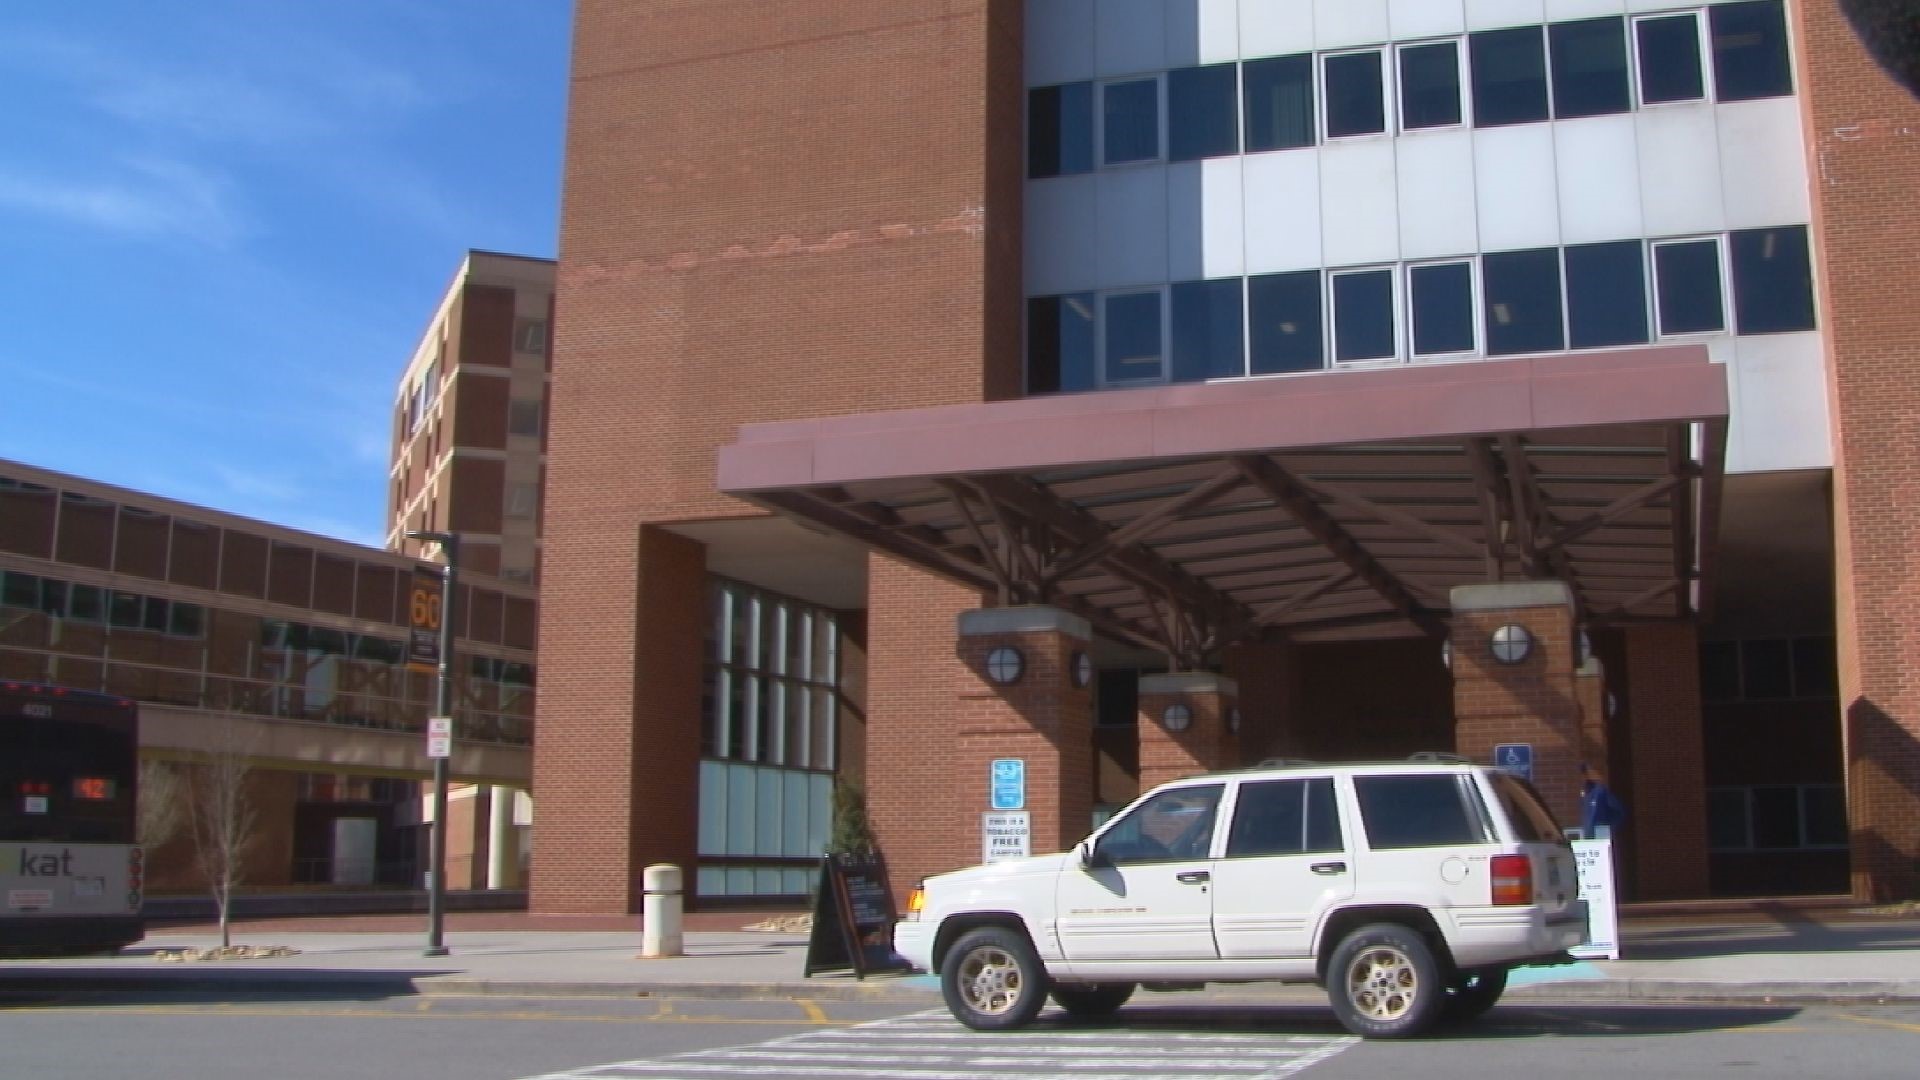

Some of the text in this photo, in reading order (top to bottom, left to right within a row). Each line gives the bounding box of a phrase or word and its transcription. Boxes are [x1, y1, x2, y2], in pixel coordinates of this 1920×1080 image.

[411, 589, 440, 628] 60
[986, 827, 1028, 835] TOBACCO
[992, 837, 1022, 846] FREE
[19, 848, 73, 876] kat
